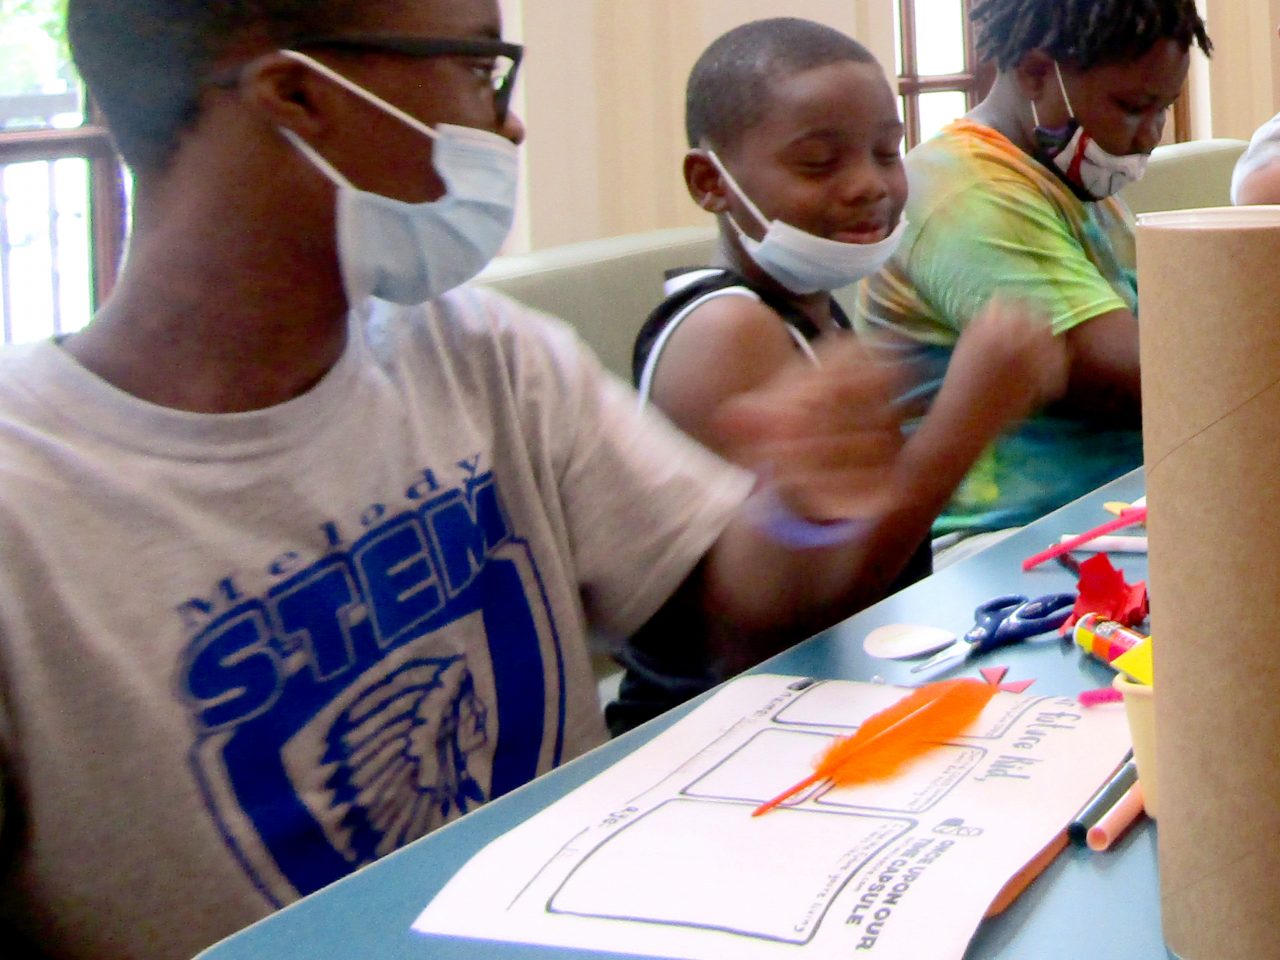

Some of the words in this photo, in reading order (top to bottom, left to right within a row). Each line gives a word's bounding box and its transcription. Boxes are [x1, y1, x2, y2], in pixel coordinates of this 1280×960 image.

[176, 453, 482, 628] Melody
[175, 470, 514, 734] STEM
[845, 859, 908, 925] CAPSULE
[882, 866, 926, 905] UPON
[855, 907, 891, 950] OUR
